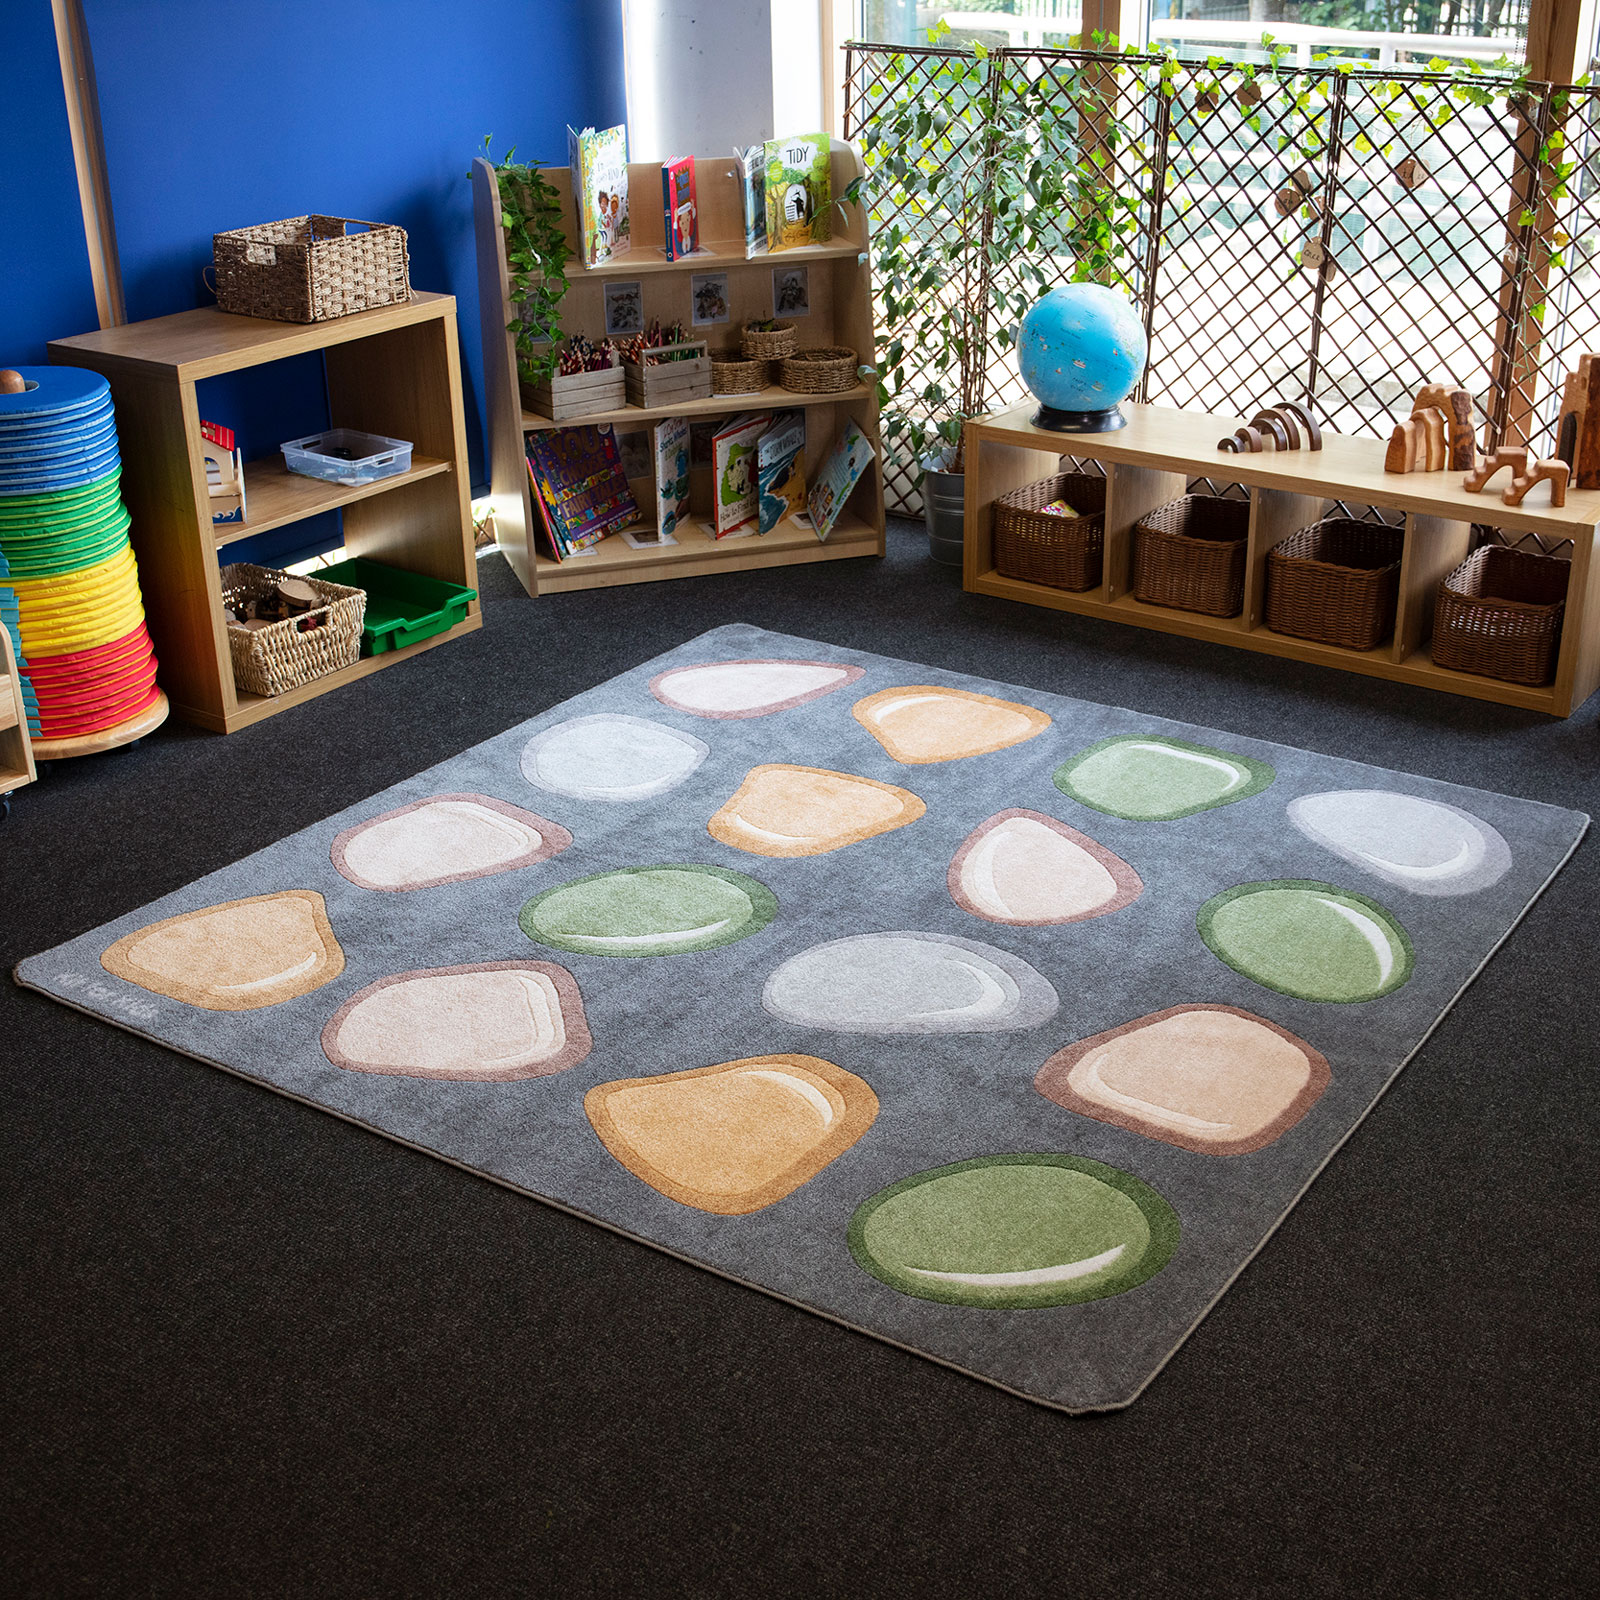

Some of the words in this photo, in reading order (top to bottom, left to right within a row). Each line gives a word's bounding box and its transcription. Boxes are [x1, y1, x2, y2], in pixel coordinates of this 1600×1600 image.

[786, 146, 809, 164] TIDY
[548, 425, 601, 464] YOU
[560, 451, 606, 486] CHOOSE
[561, 491, 593, 518] FAIRY
